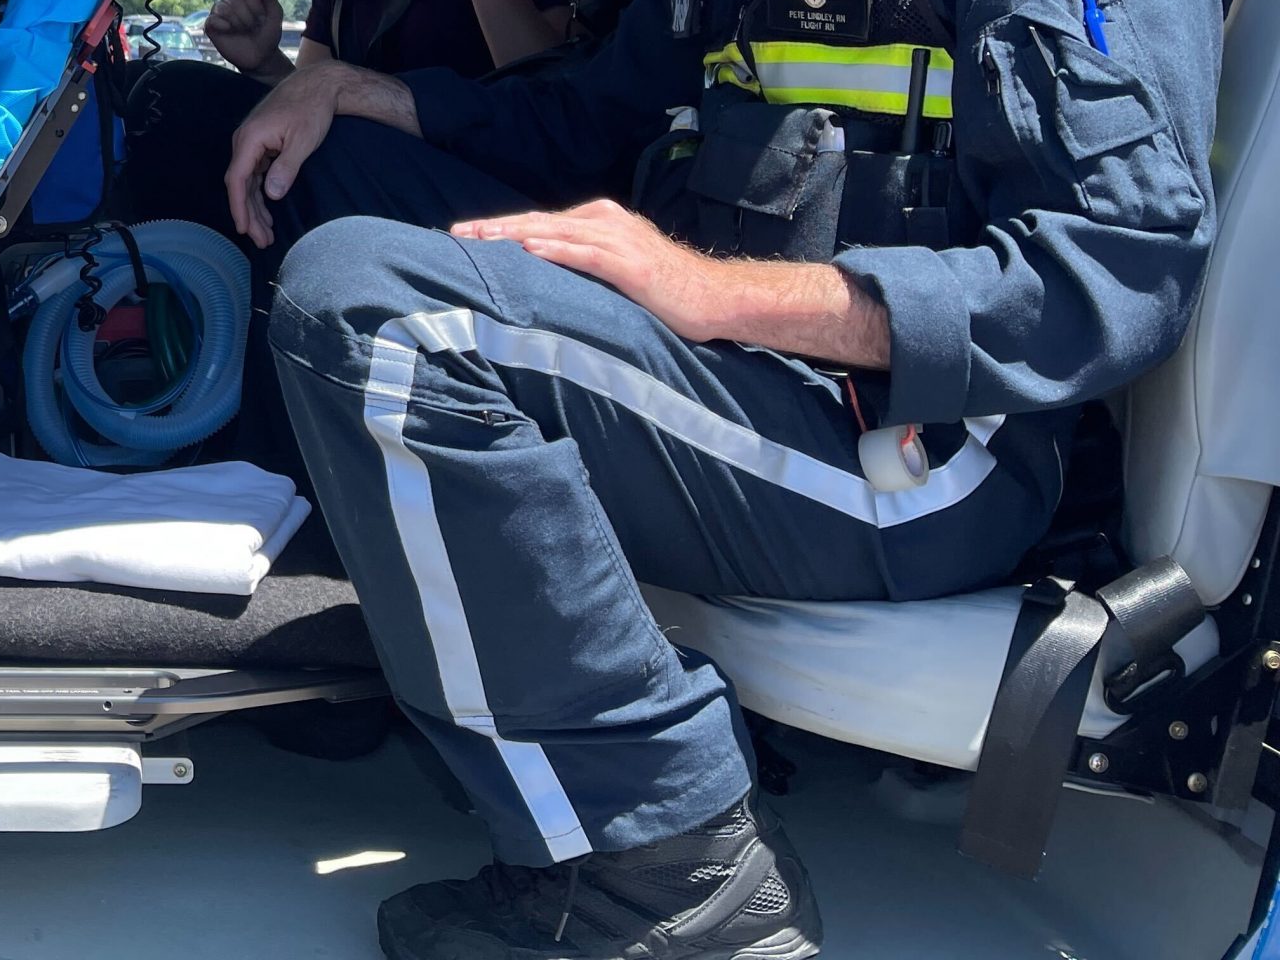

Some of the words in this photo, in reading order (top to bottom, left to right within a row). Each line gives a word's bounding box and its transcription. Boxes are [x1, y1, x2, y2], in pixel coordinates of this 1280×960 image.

[789, 10, 805, 19] PETE
[835, 14, 846, 23] RN
[800, 20, 822, 30] FLIGHT
[824, 22, 835, 31] RN
